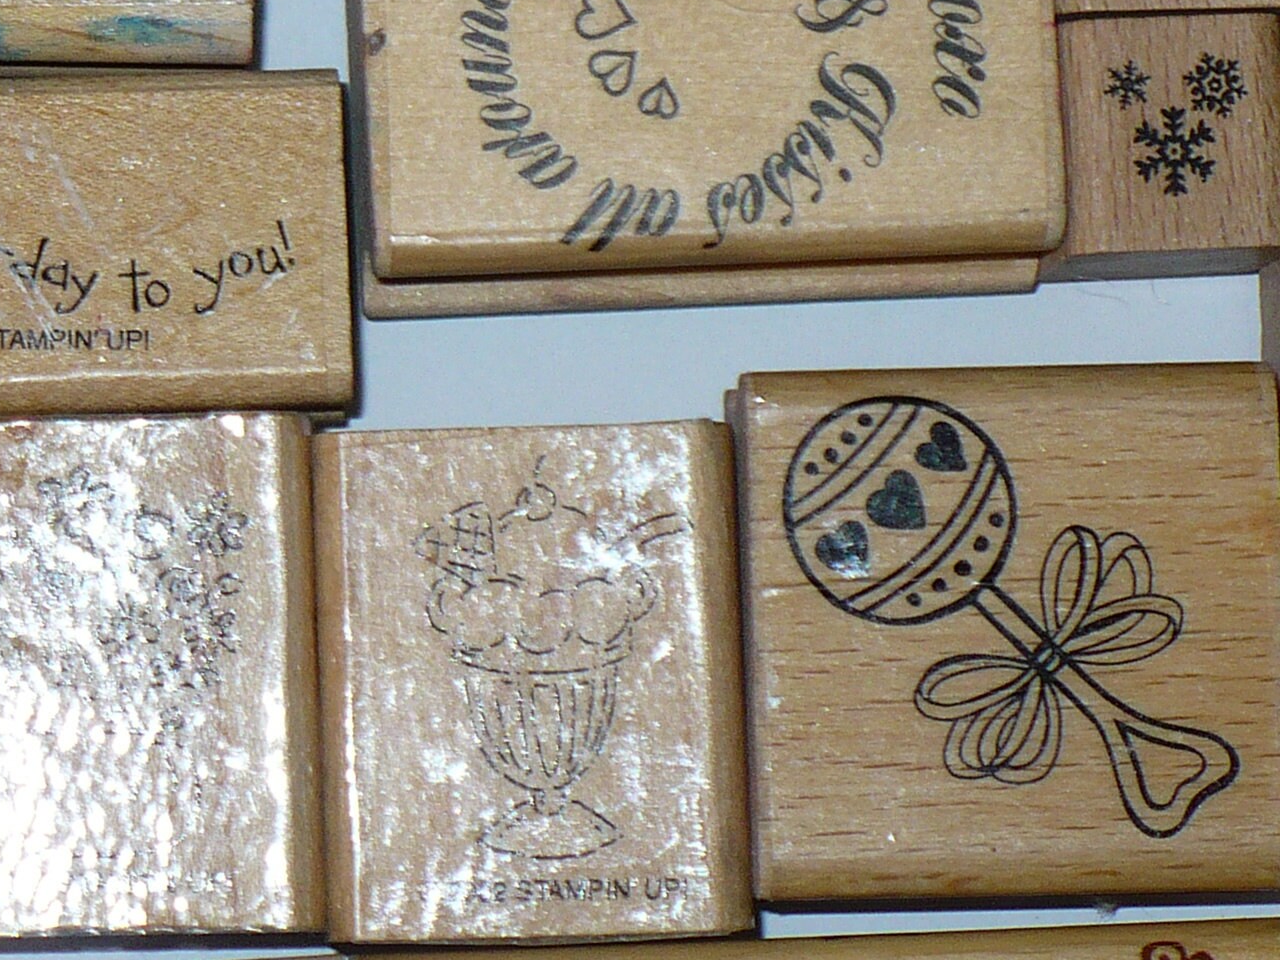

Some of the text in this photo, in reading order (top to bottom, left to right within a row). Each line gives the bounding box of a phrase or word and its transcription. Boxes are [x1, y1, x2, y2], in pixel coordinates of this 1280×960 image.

[702, 50, 896, 249] Kisses
[560, 177, 680, 253] all
[117, 258, 172, 314] to
[192, 219, 297, 315] you!
[105, 330, 149, 351] UP!
